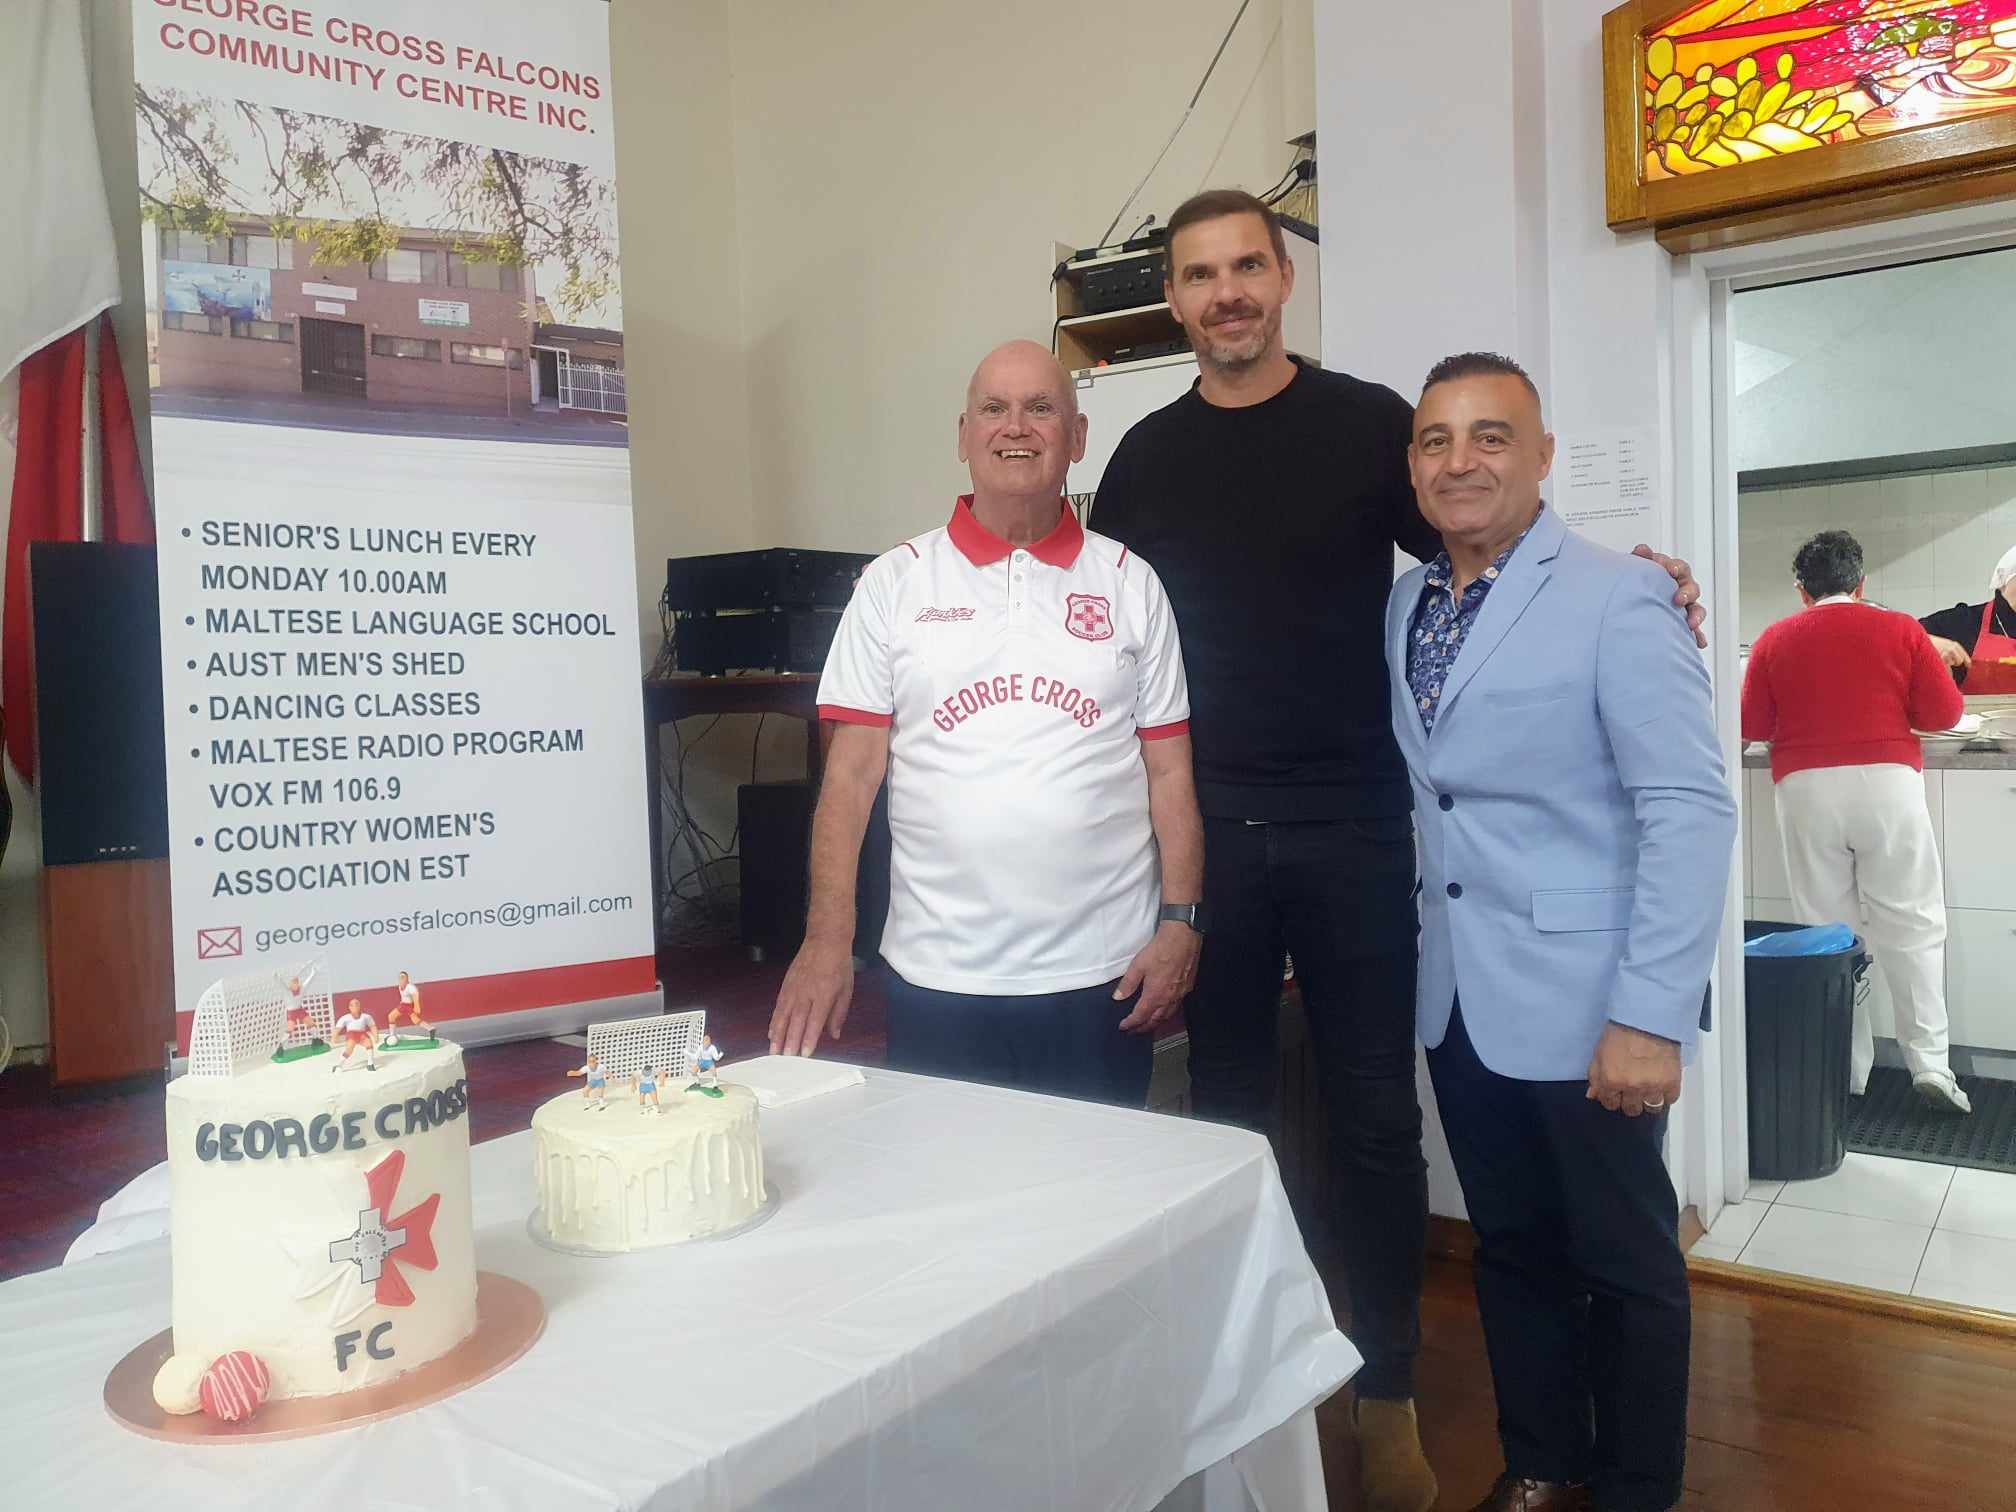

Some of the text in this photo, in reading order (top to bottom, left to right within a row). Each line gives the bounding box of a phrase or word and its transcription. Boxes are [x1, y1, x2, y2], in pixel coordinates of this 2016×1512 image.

[160, 23, 594, 134] COMMUNITY CENTRE INC.
[326, 18, 445, 64] CROSS
[457, 47, 600, 99] FALCONS
[202, 521, 536, 556] SENIOR'S LUNCH EVERY
[202, 565, 446, 594] MONDAY 10.00AM
[206, 608, 616, 635] MALTESE LANGUAGE SCHOOL
[206, 652, 464, 677] AUST MEN'S SHED
[210, 692, 480, 720] DANCING CLASSES
[933, 673, 1101, 733] GEORGE CROSS
[212, 729, 583, 764] MALTESE RADIO PROGRAM
[209, 777, 400, 808] VOX FM 106.9
[215, 812, 495, 852] COUNTRY WOMEN'S
[213, 854, 470, 897] ASSOCIATION EST
[256, 896, 632, 952] georgecrossfalcons@gmail.com
[195, 1078, 469, 1162] GEORGE CROSS
[334, 1321, 396, 1373] FC
